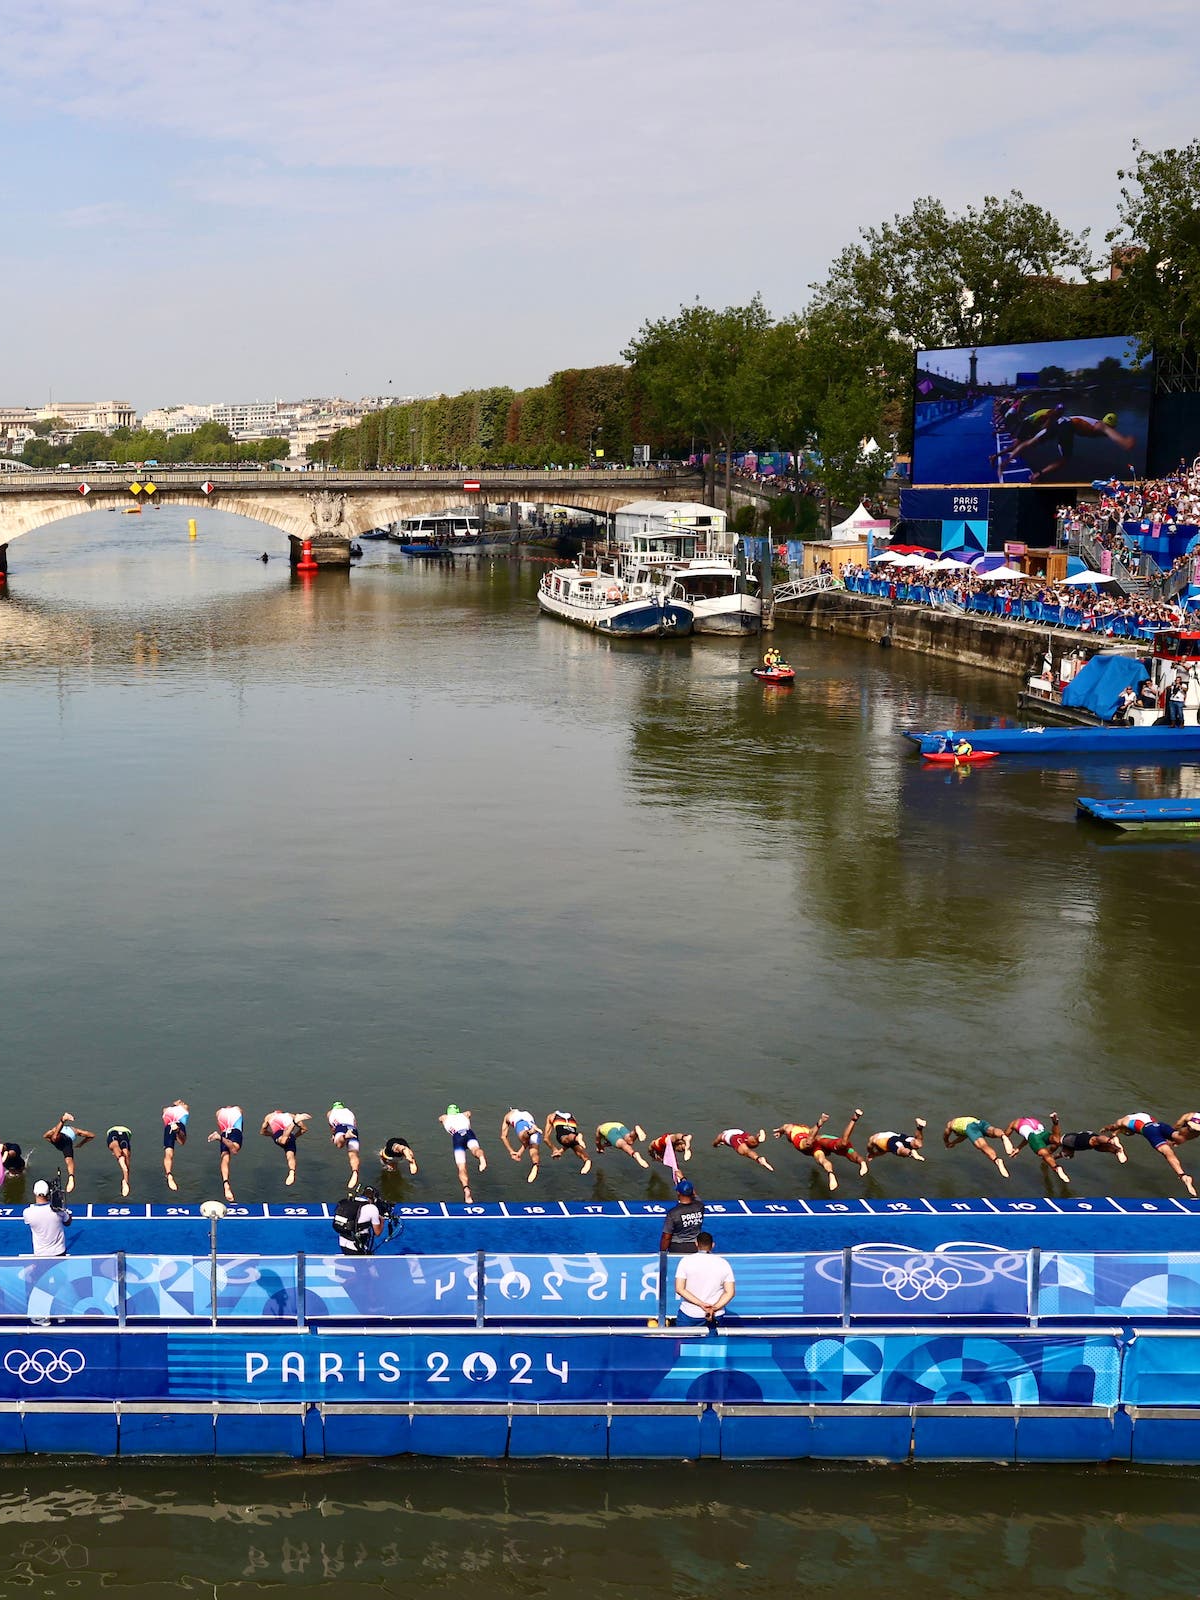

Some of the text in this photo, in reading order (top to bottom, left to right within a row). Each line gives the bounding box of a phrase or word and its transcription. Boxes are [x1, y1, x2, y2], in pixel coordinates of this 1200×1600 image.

[953, 504, 978, 513] 2024
[400, 1207, 430, 1215] 20
[463, 1206, 485, 1215] 19
[523, 1206, 546, 1214] 18
[583, 1205, 603, 1213] 17
[643, 1204, 666, 1213] 16
[703, 1204, 727, 1213] 15
[764, 1204, 789, 1212] 14
[825, 1203, 849, 1212] 13
[886, 1202, 912, 1211] 12
[951, 1202, 972, 1211] 11
[1007, 1202, 1037, 1211] 10
[1077, 1202, 1093, 1211] 9
[1141, 1203, 1158, 1211] 8
[107, 1207, 131, 1216] 25
[166, 1207, 190, 1216] 24
[226, 1207, 249, 1216] 23
[283, 1207, 309, 1216] 22
[681, 1211, 703, 1221] PARIS
[426, 1351, 569, 1384] 2024
